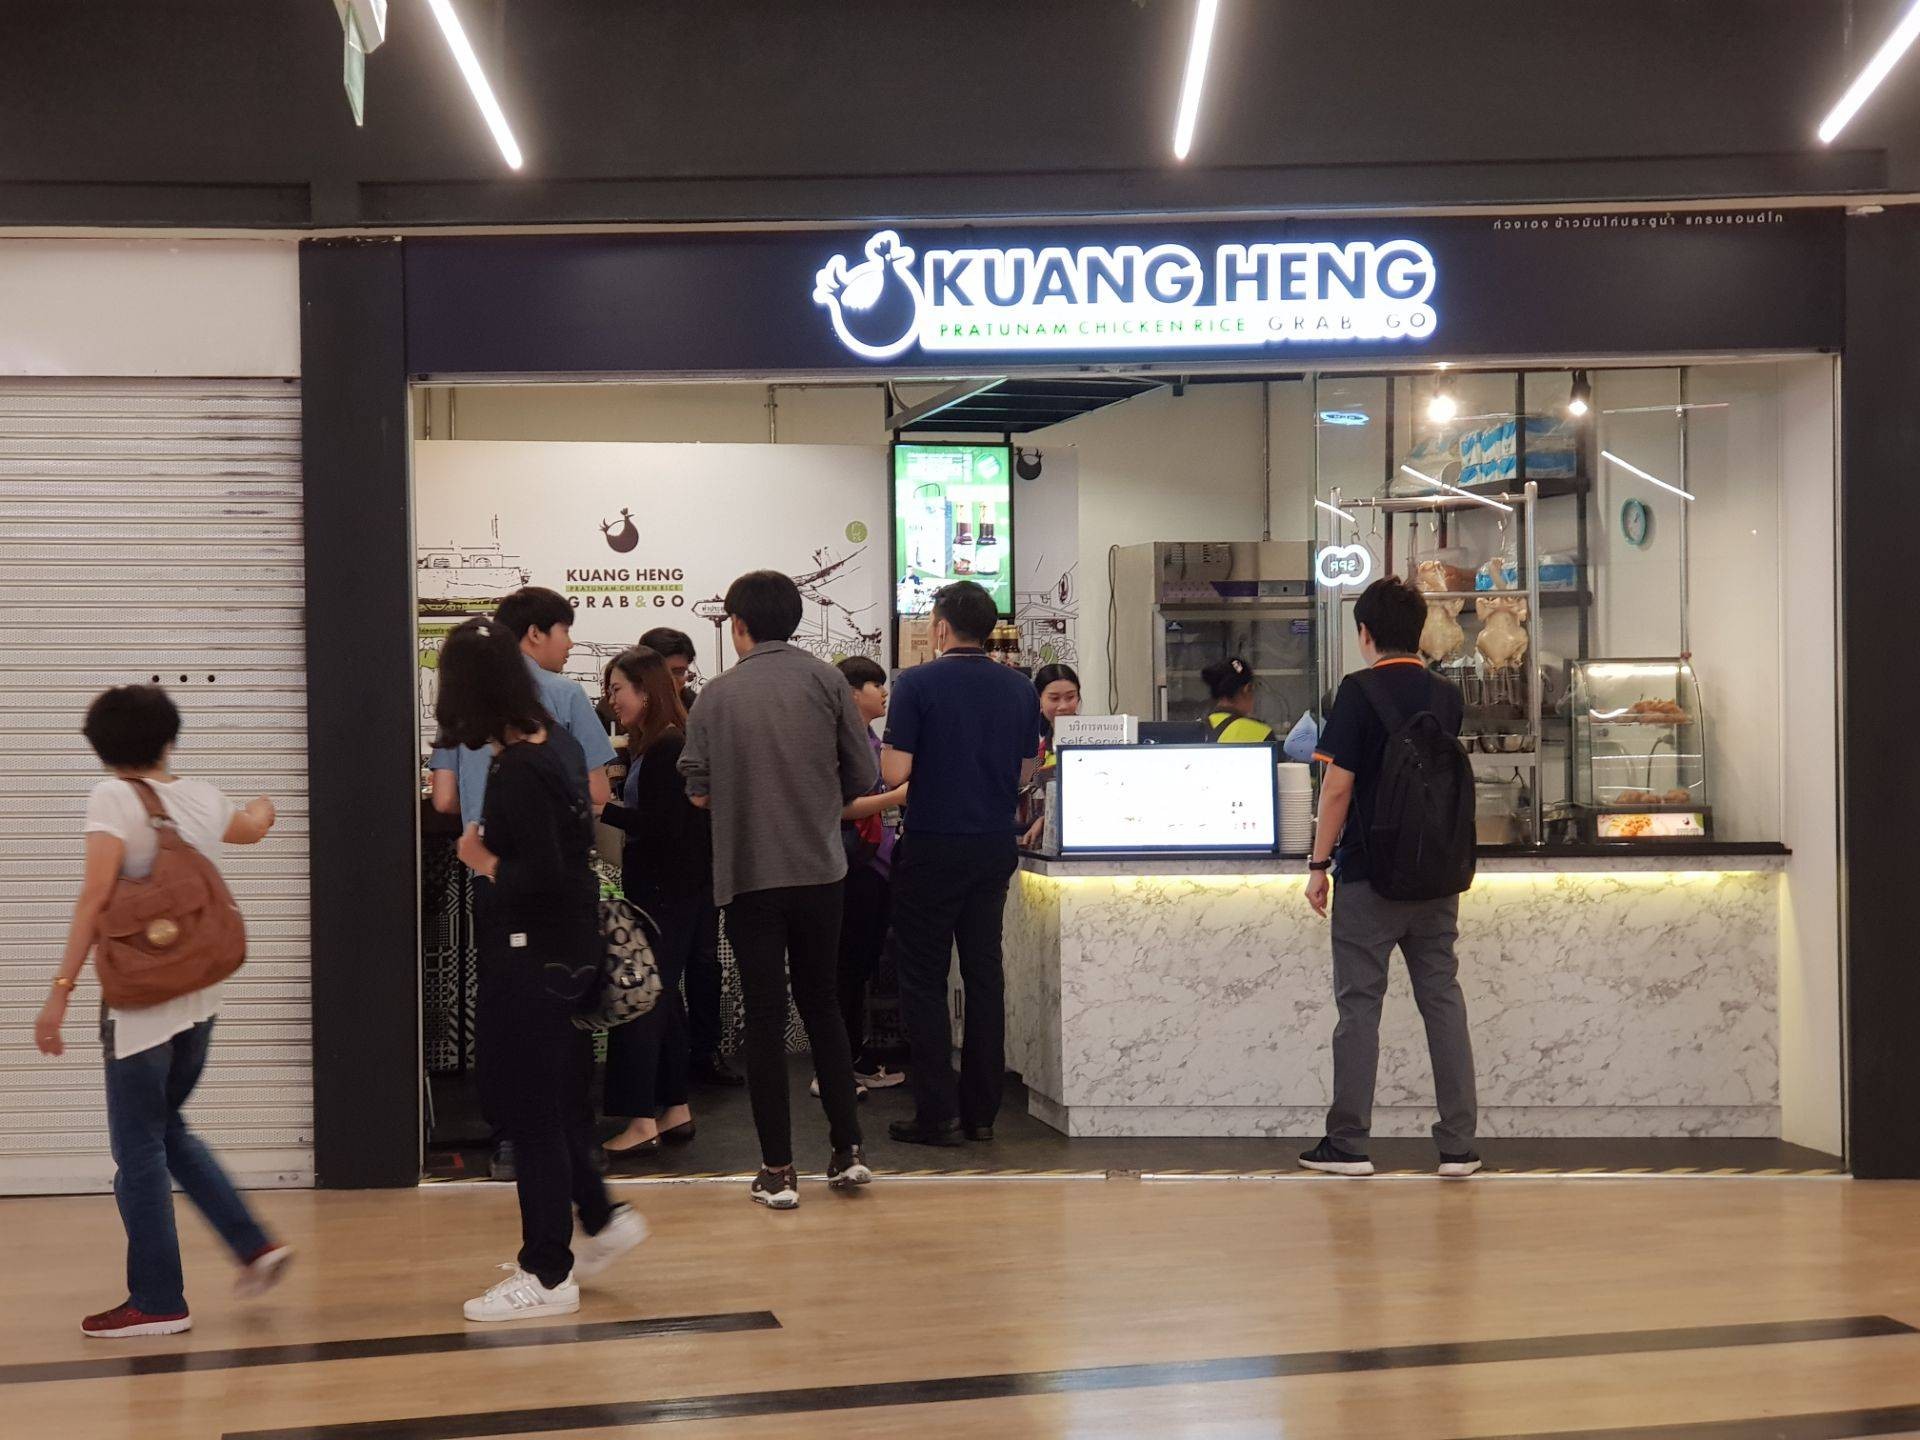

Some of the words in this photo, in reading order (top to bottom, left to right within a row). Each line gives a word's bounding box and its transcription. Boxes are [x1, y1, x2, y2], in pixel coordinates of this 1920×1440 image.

[933, 252, 1195, 306] KUANG
[1225, 249, 1427, 302] HENG
[940, 322, 1068, 337] PRATUNAM
[1078, 319, 1183, 335] CHICKEN
[1194, 317, 1246, 332] RICE
[1267, 315, 1353, 331] GRAB
[1385, 312, 1426, 329] GO
[566, 569, 630, 581] KUANG
[636, 568, 684, 581] HENG
[568, 595, 629, 608] GRAB
[653, 595, 685, 608] GO
